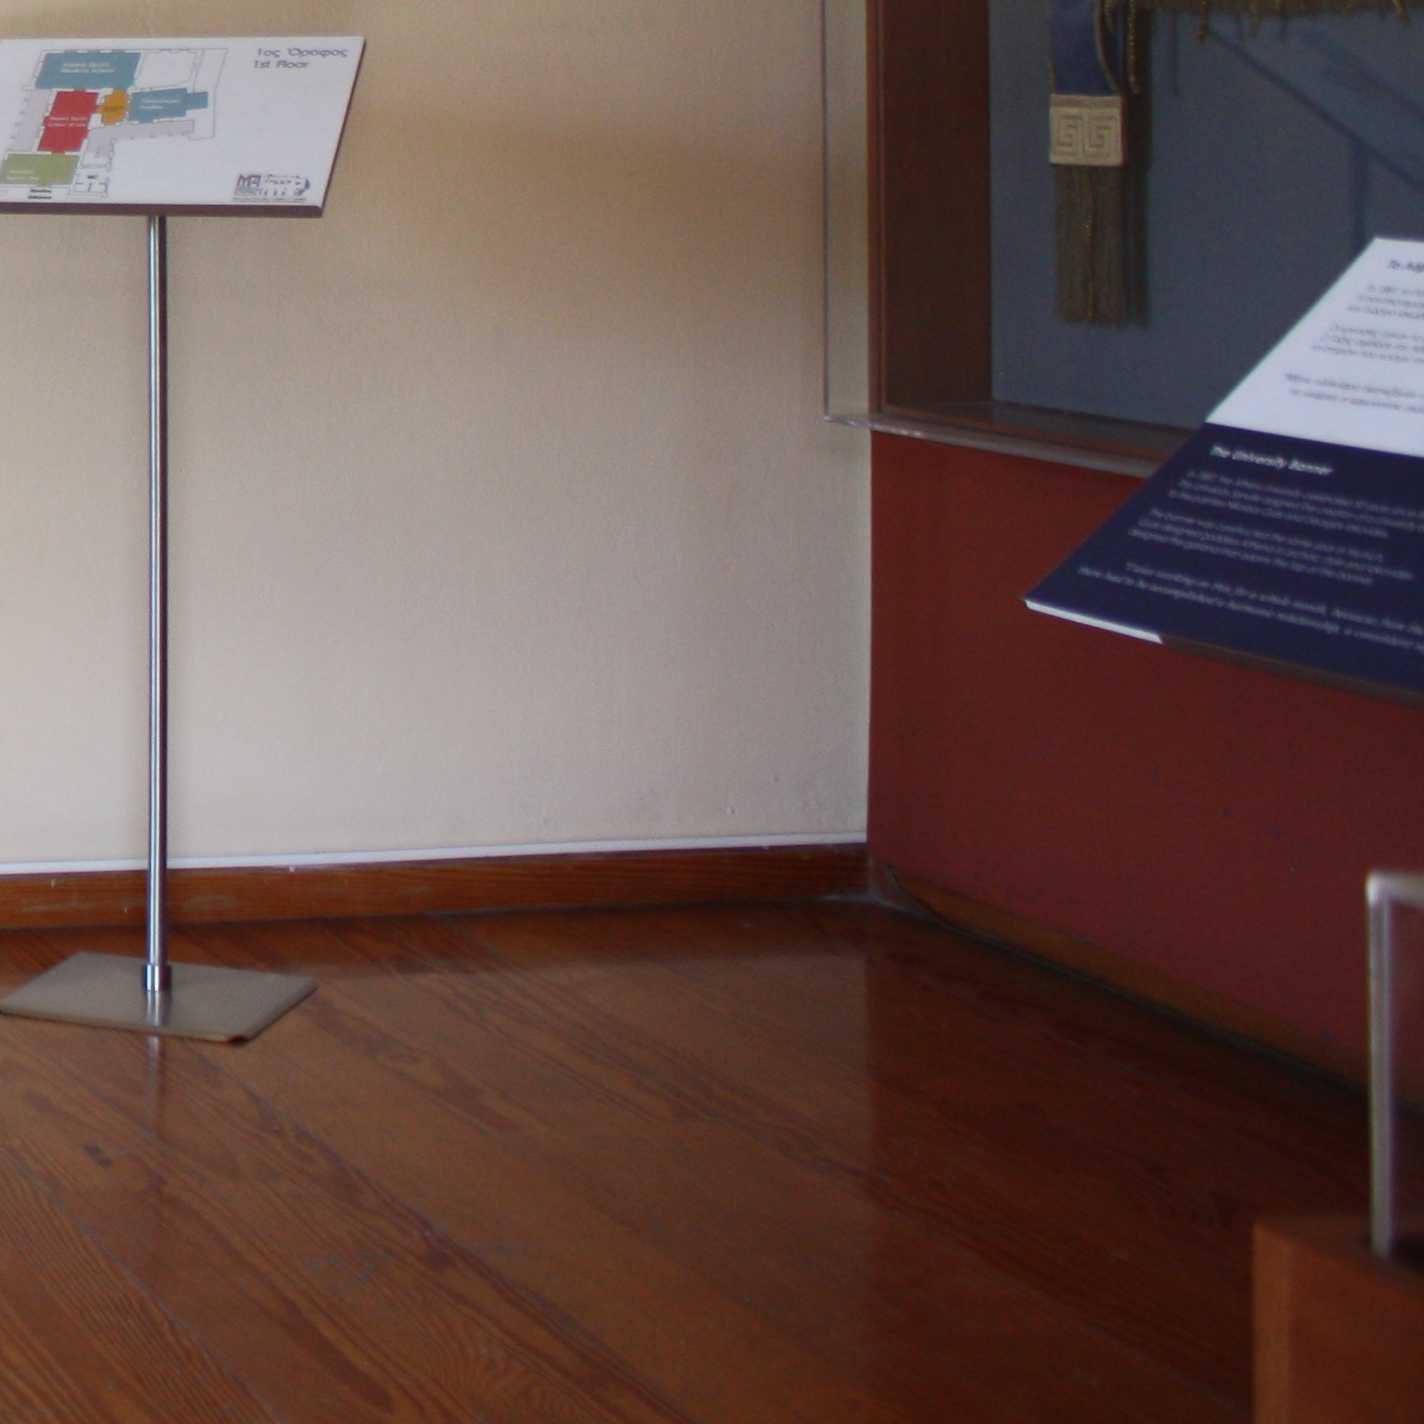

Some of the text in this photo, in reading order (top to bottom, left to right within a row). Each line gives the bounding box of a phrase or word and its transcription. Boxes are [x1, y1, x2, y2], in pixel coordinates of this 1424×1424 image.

[254, 60, 309, 68] 1st Floor
[1210, 445, 1231, 458] The
[1232, 450, 1287, 469] University
